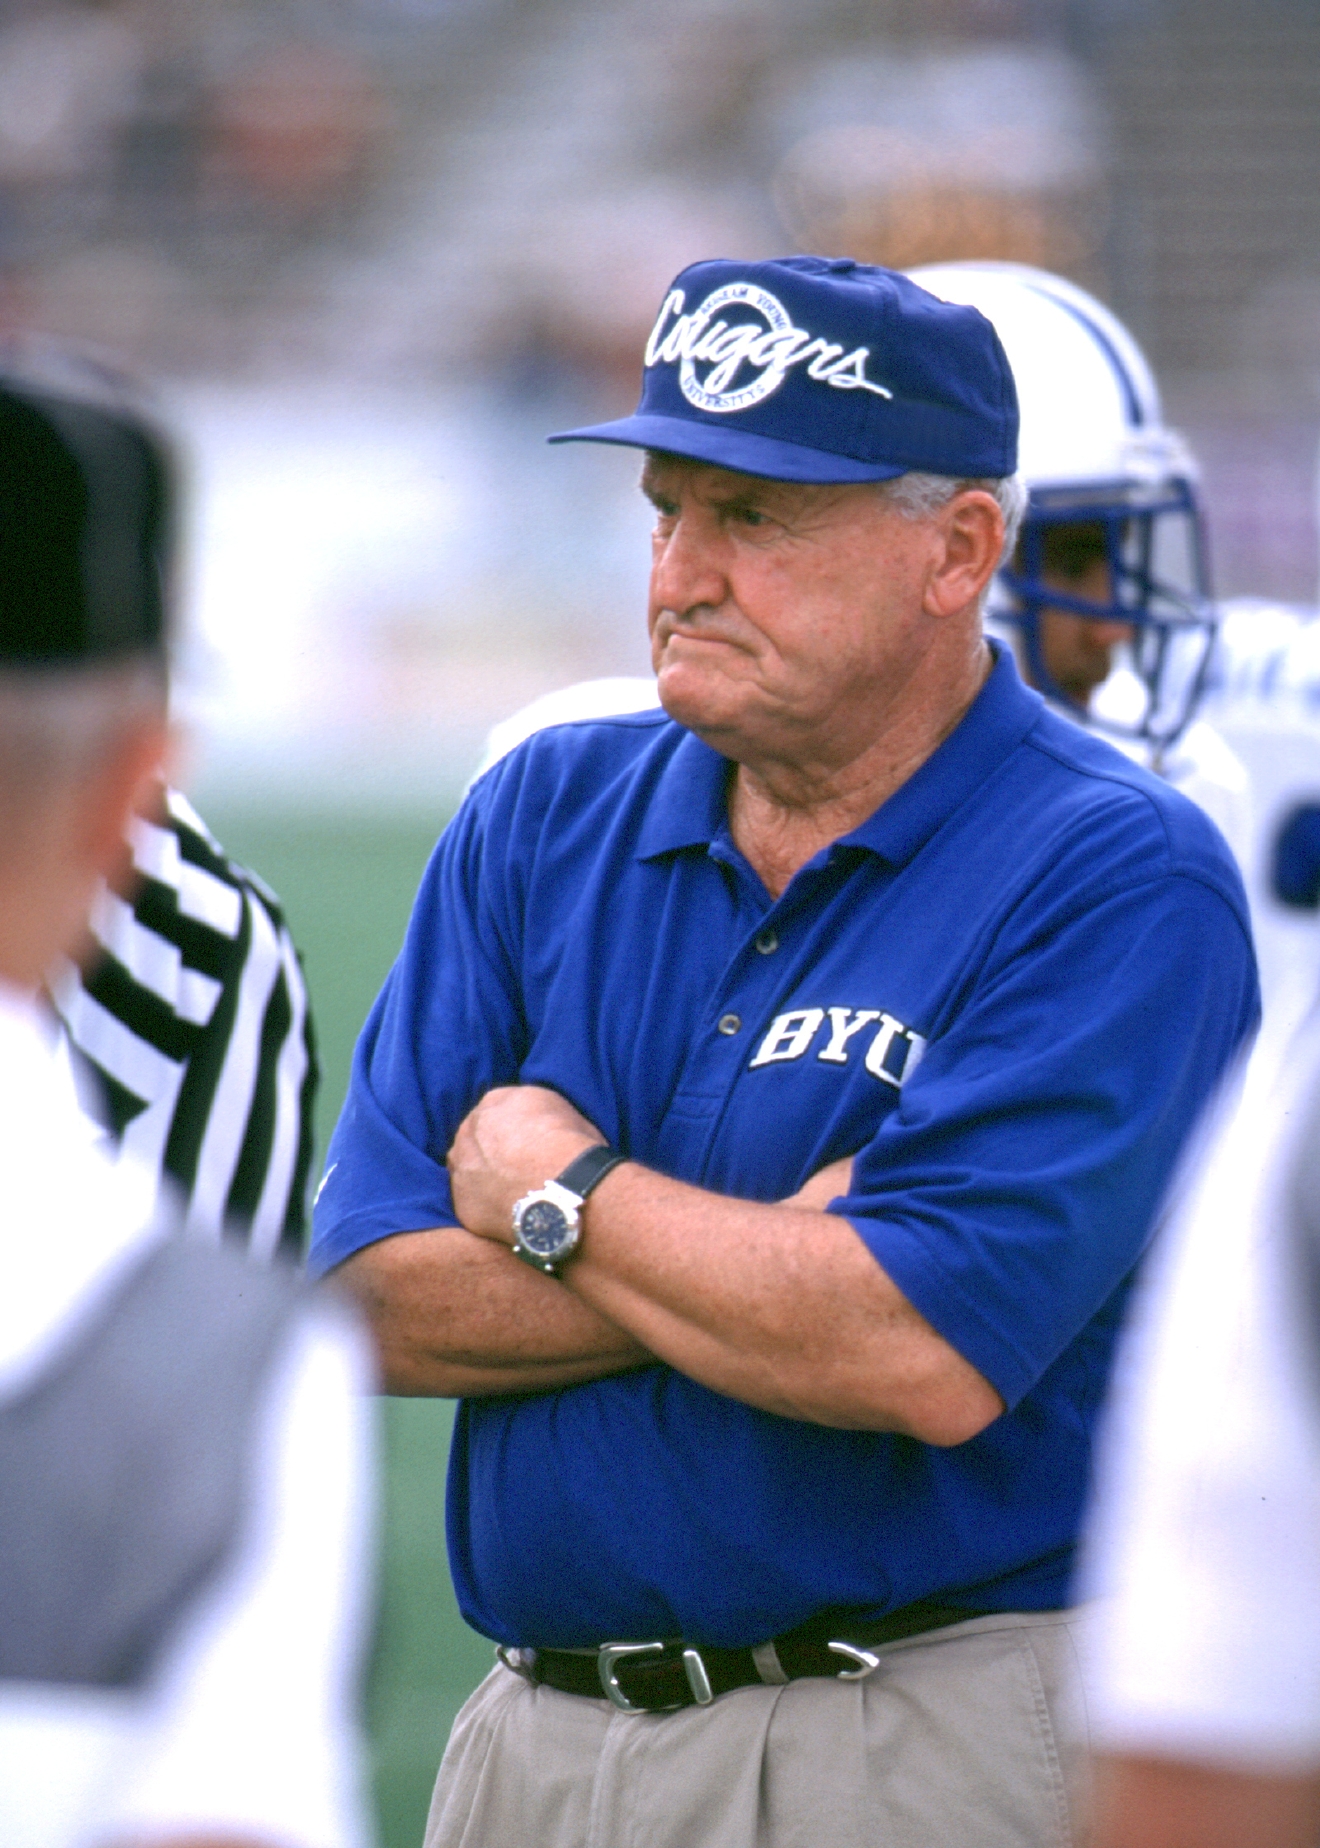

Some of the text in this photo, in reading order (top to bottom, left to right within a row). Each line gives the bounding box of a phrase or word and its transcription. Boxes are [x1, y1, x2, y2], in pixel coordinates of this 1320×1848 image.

[644, 288, 893, 399] Cougars
[756, 292, 788, 331] YOUNG
[748, 1006, 927, 1089] BYU
